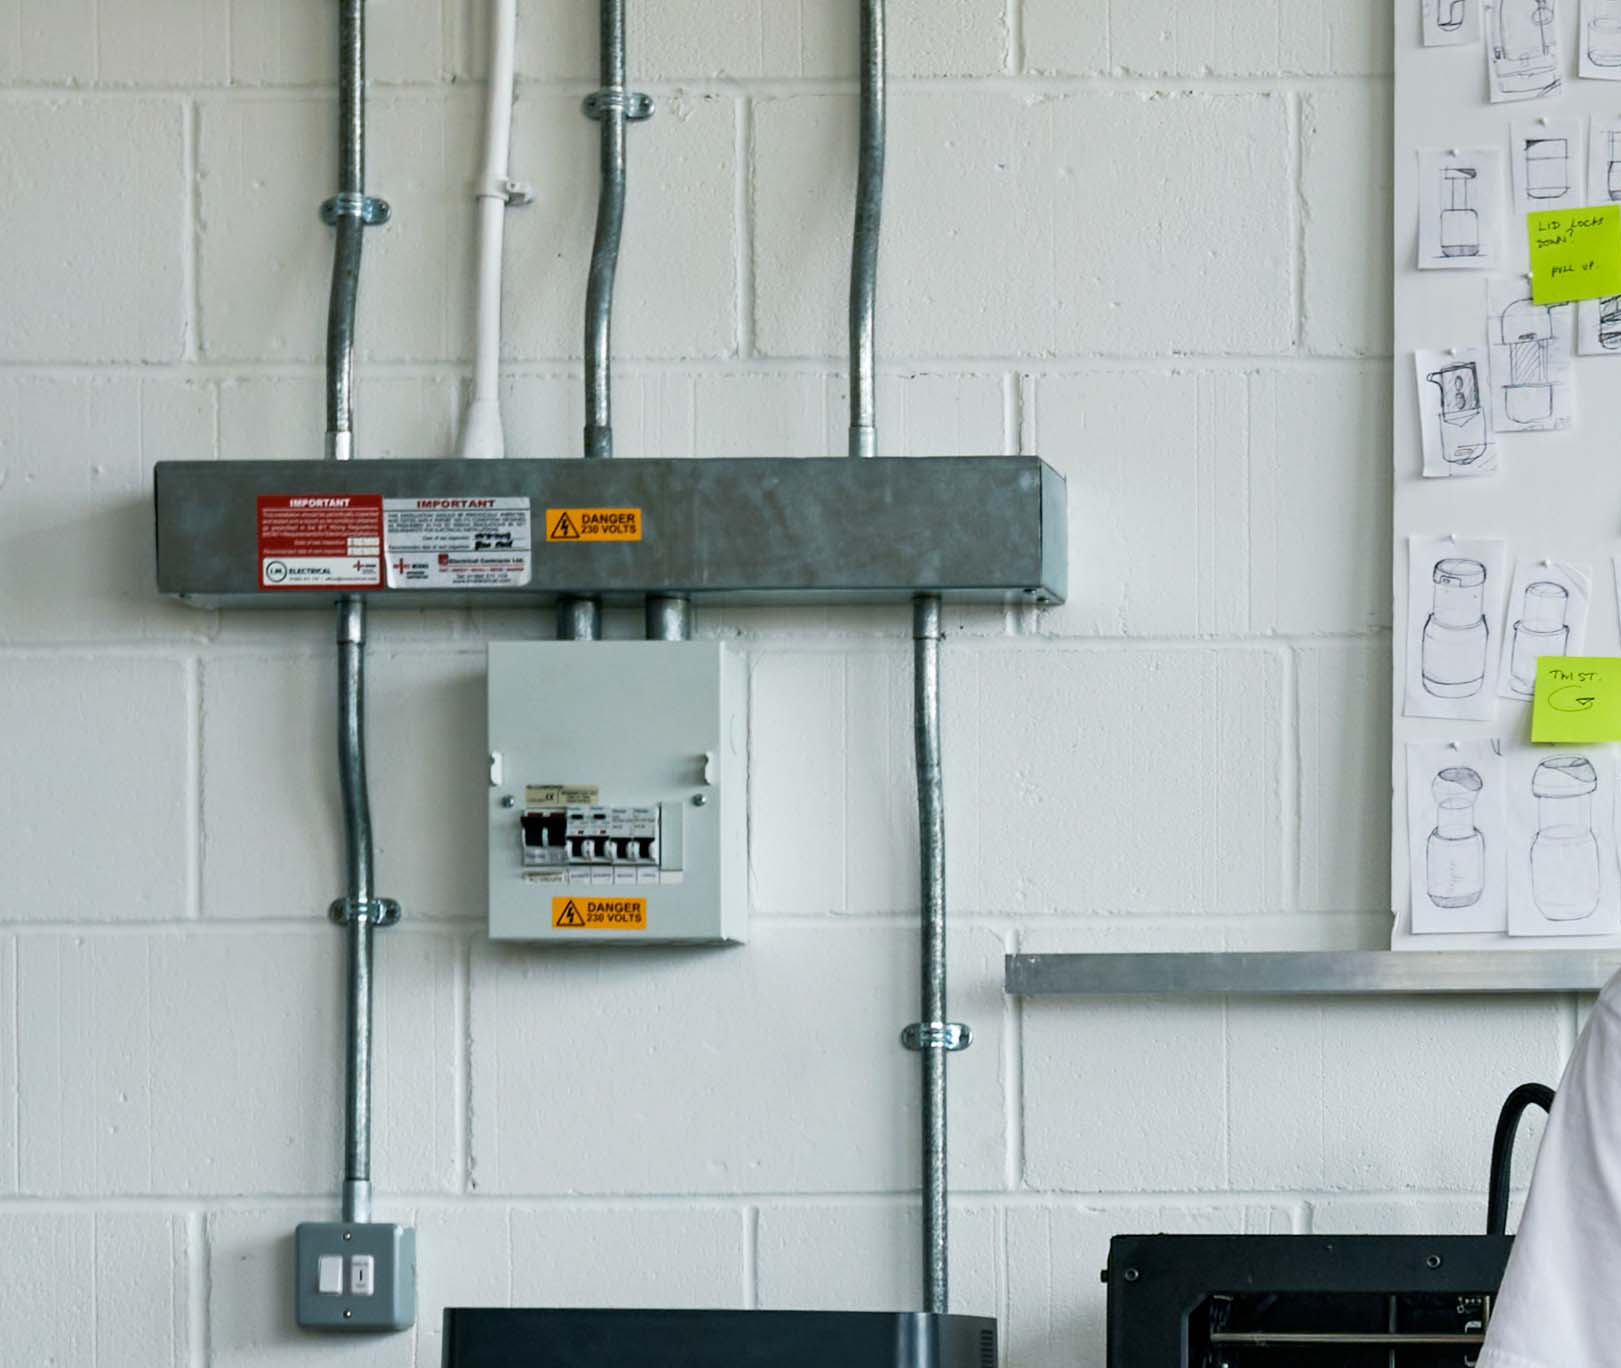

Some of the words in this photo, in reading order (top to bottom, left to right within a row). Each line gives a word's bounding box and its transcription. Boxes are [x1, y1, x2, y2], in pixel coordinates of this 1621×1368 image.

[289, 497, 351, 508] IMPORTANT
[416, 499, 496, 509] IMPORTANT
[581, 513, 635, 524] DANGER
[580, 524, 600, 534] 230
[601, 524, 637, 534] VOLTS
[586, 901, 641, 913] DANGER
[586, 912, 605, 923] 230
[607, 912, 643, 923] VOLTS
